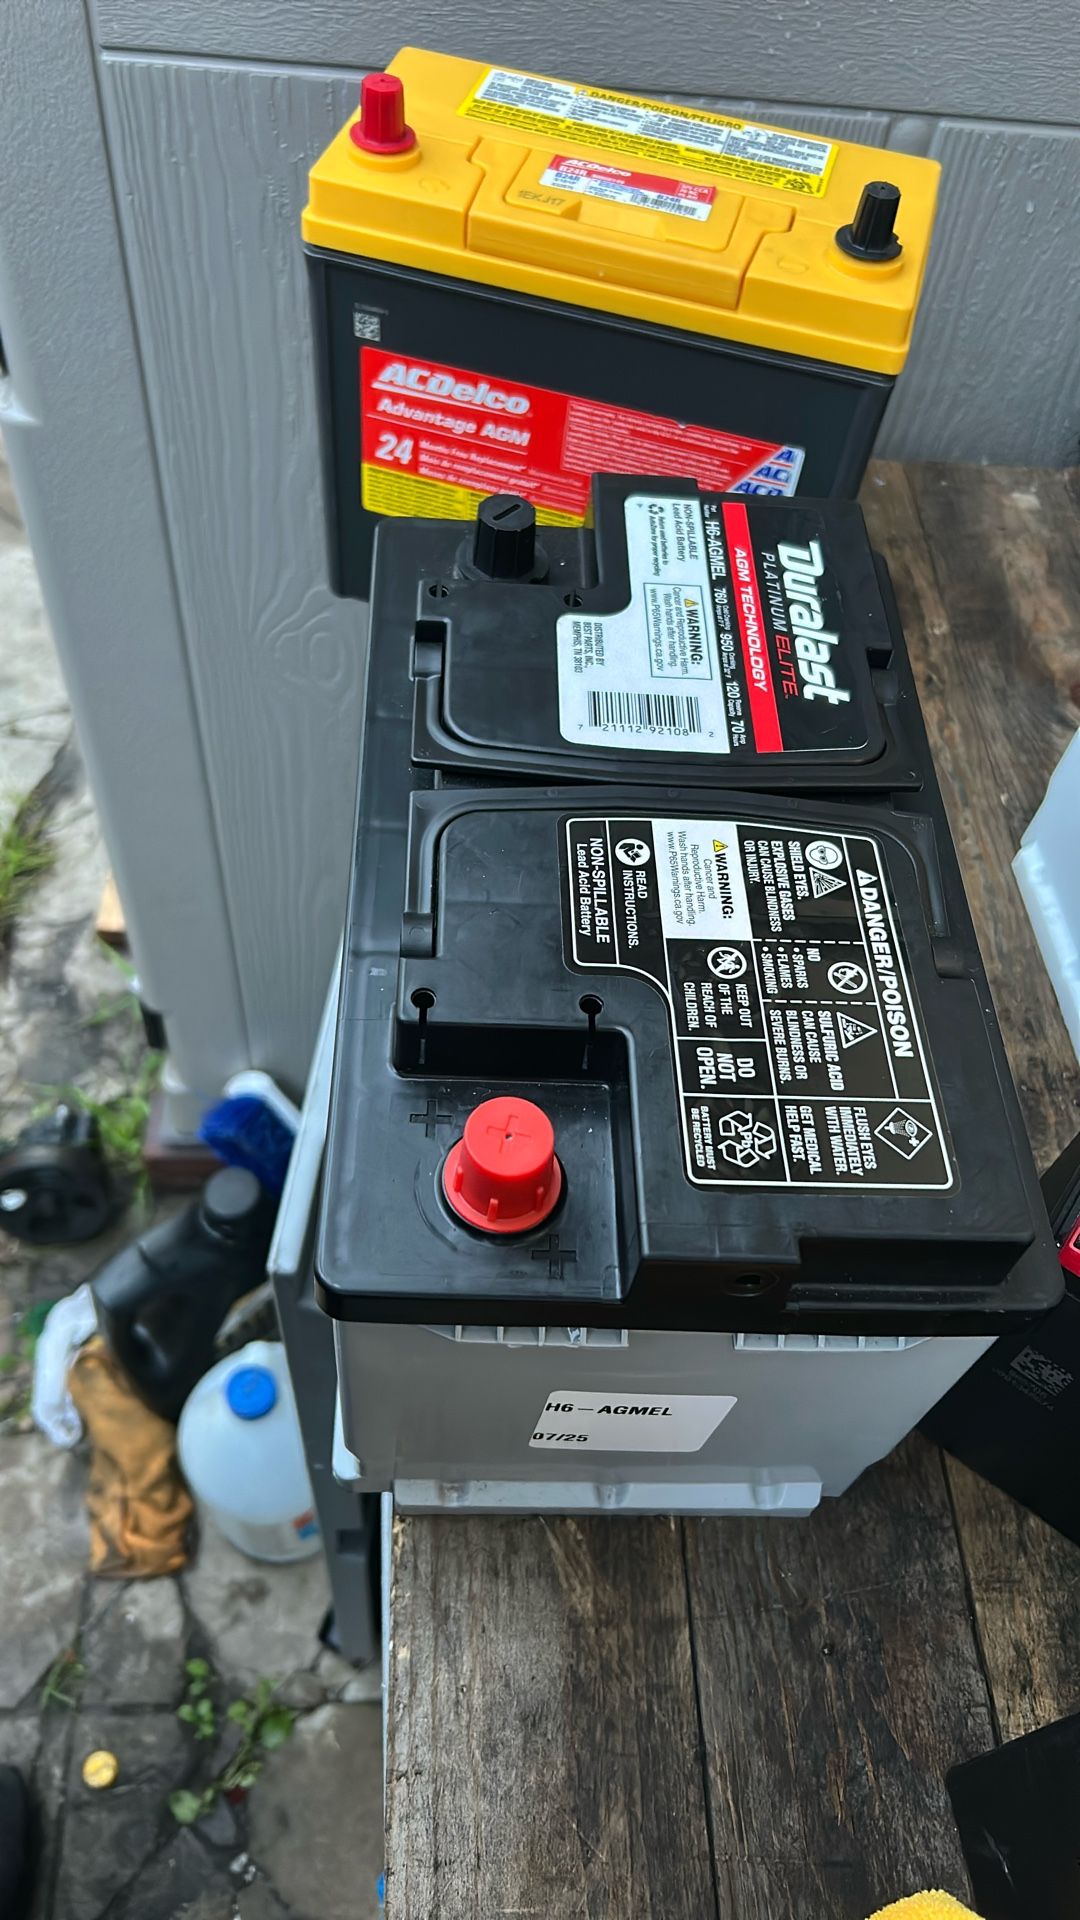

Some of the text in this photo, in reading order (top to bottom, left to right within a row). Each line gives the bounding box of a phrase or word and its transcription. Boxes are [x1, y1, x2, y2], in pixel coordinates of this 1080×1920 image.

[590, 91, 742, 130] DANGER/POISON/PELIGRO
[558, 165, 588, 177] B24R
[563, 158, 632, 178] ACDelco
[377, 362, 530, 414] ACDelco
[374, 432, 414, 465] 24
[376, 398, 531, 447] Advantage AGM
[672, 503, 686, 562] Lead Acid Battery
[684, 504, 698, 560] NON-SPILLABLE
[705, 521, 726, 580] H6-AGMEL
[714, 588, 727, 604] 760
[734, 547, 768, 692] AGM TECHNOLOGY
[777, 540, 850, 704] Duralast
[572, 621, 582, 673] MEMPHIS, TN 38103
[583, 622, 592, 636] BEST
[584, 636, 593, 654] PARTS,
[594, 622, 604, 666] DISTRIBUTED BY
[650, 588, 664, 671] www.P65Warnings.ca.gov
[663, 593, 679, 668] Wash hands after handling.
[672, 587, 690, 675] Cancer and Reproductive Harm.
[686, 609, 702, 665] WARNING:
[719, 633, 734, 651] 950
[761, 552, 798, 696] PLATINUM ELITE
[725, 681, 740, 698] 120
[728, 699, 736, 717] Capacity
[734, 700, 742, 716] Reserve
[602, 724, 642, 734] 21112
[650, 726, 689, 736] 92108
[730, 720, 744, 733] 70
[732, 734, 740, 746] Hours
[635, 870, 648, 899] READ
[666, 831, 684, 924] www.P65Warnings.ca.gov
[678, 831, 696, 926] Wash hands after handling.
[690, 844, 706, 914] Reproductive Harm.
[704, 858, 717, 899] Cancer and
[714, 852, 734, 919] WARNING:
[744, 840, 760, 884] OR INJURY.
[758, 840, 782, 932] CAN CAUSE BLINDNESS
[770, 840, 796, 920] EXPLOSIVE GASES
[788, 840, 810, 900] SHIELD EYES.
[576, 843, 592, 936] Lead Acid Battery
[589, 838, 610, 944] NON-SPILLABLE
[622, 870, 639, 949] INSTRUCTIONS.
[760, 953, 778, 994] SMOKING
[776, 953, 793, 988] FLAMES
[792, 954, 808, 988] SPARKS
[806, 948, 821, 962] NO
[859, 887, 914, 1058] DANGER/POISON
[683, 982, 700, 1031] CHILDREN.
[700, 982, 717, 1028] REACH OF
[718, 983, 733, 1015] OF THE
[735, 983, 752, 1028] KEEP OUT
[769, 1009, 792, 1084] SEVERE BURNS.
[785, 1010, 808, 1080] BLINDNESS OR
[801, 1010, 822, 1064] CAN CAUSE
[817, 1010, 844, 1091] SULFURIC ACID
[696, 1046, 717, 1089] OPEN.
[716, 1053, 736, 1082] NOT
[736, 1057, 756, 1078] DO
[691, 1108, 705, 1167] BE RECYCLED
[700, 1106, 716, 1170] BATTERY MUST
[739, 1131, 753, 1148] Pb
[784, 1105, 806, 1162] HELP FAST.
[799, 1106, 822, 1175] GET MEDICAL
[824, 1106, 848, 1176] WITH WATER.
[838, 1106, 863, 1176] IMMEDIATELY
[853, 1106, 877, 1170] FLUSH EYES
[532, 1432, 589, 1442] 07/25
